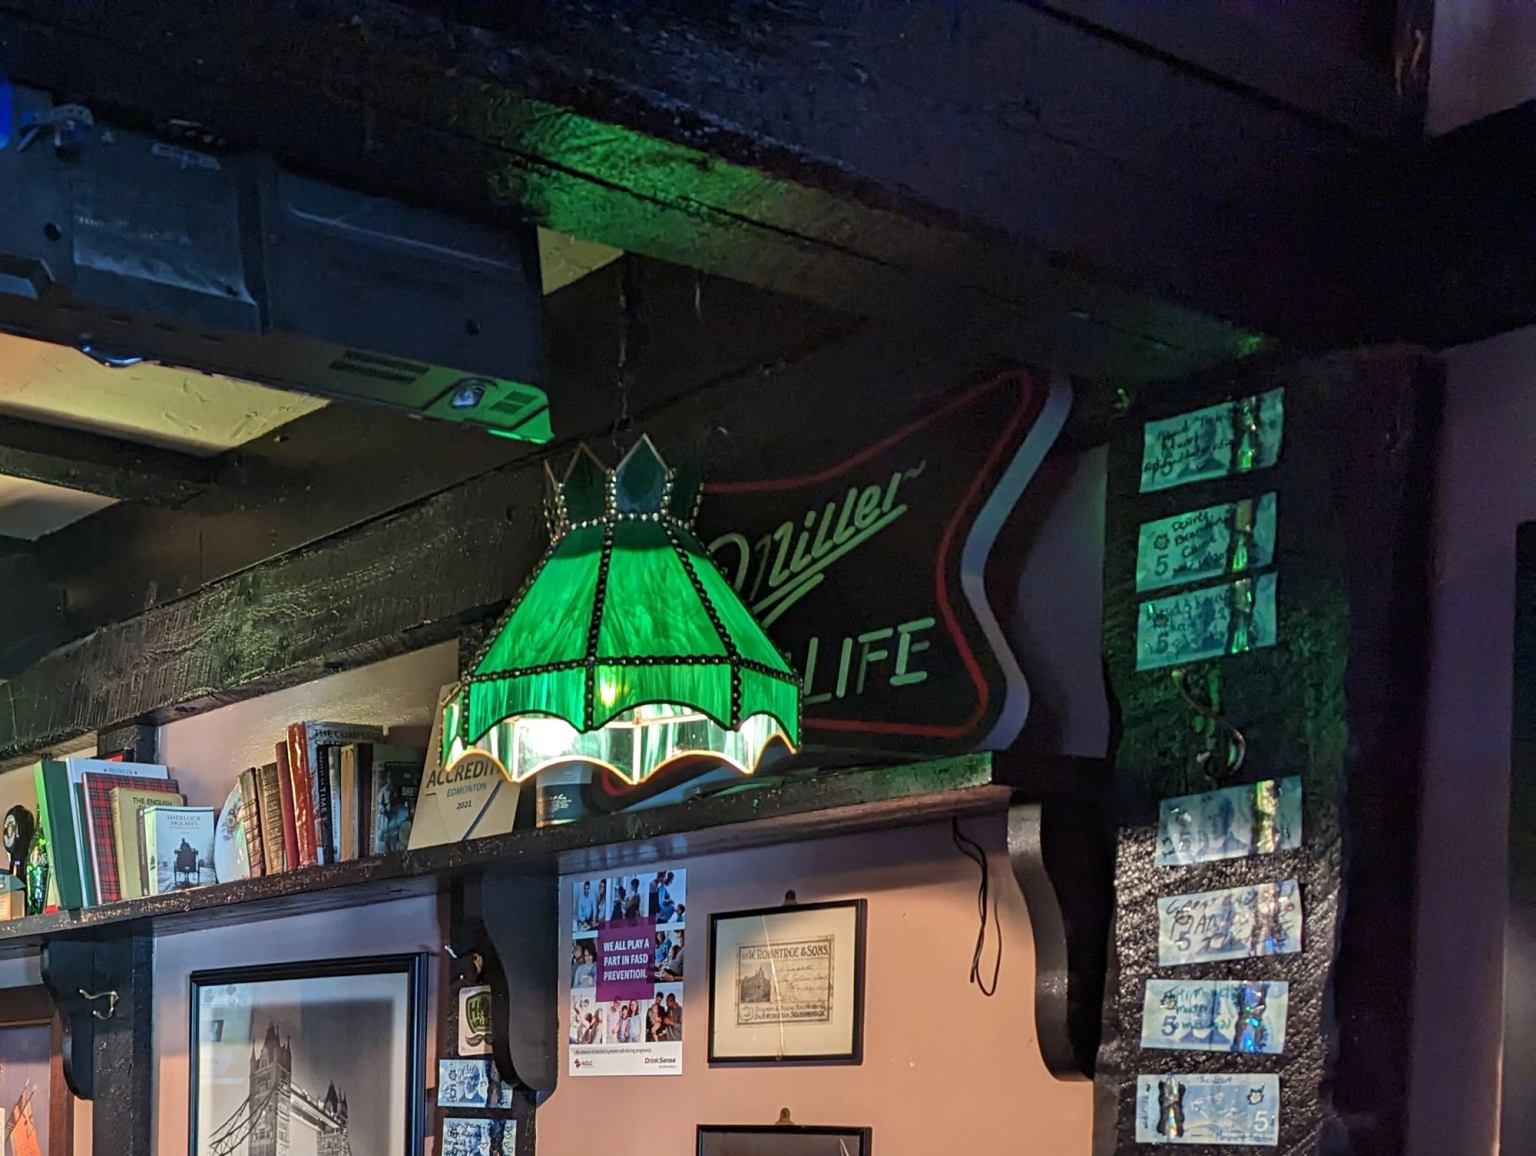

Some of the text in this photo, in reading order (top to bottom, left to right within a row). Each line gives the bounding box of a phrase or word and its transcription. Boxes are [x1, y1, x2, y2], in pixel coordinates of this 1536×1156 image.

[1154, 554, 1169, 576] 5
[804, 618, 935, 704] LIFE
[446, 782, 487, 797] EDMONTON
[603, 938, 650, 952] WE ALL PLAY A
[603, 953, 649, 966] PART IN FASD
[603, 968, 648, 981] PREVENTION.
[1161, 1015, 1176, 1036] 5
[1254, 1110, 1269, 1132] 5
